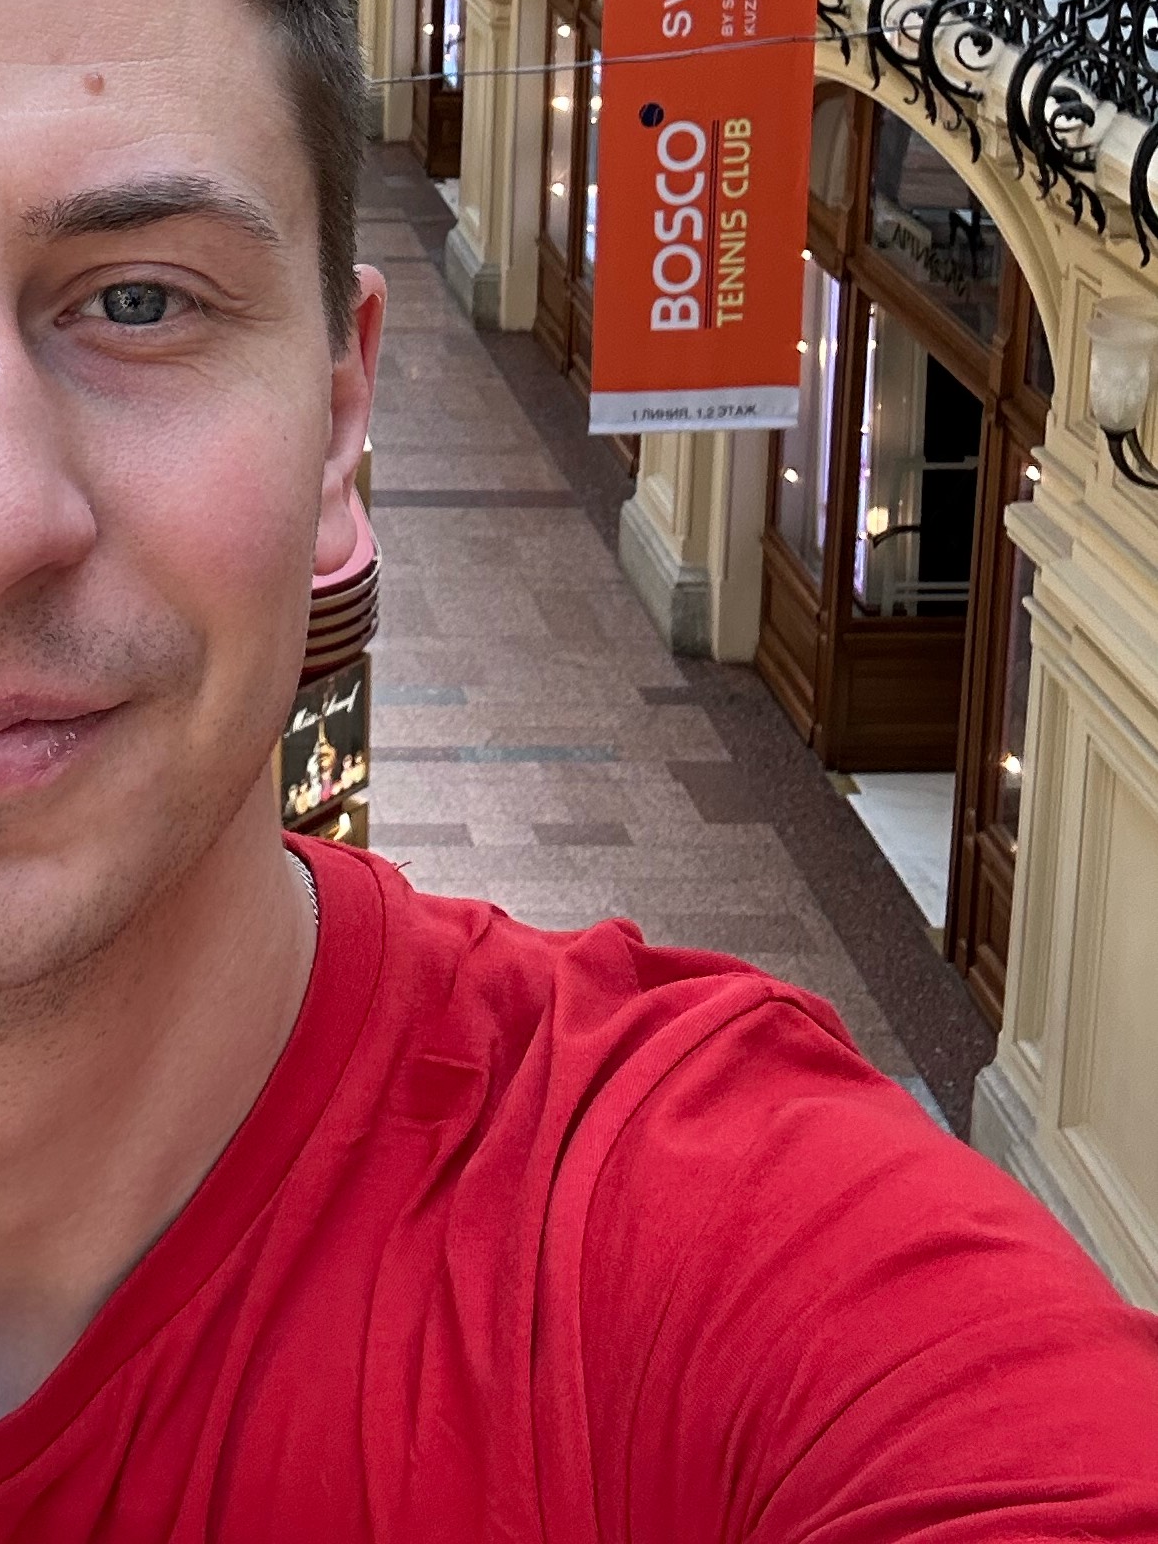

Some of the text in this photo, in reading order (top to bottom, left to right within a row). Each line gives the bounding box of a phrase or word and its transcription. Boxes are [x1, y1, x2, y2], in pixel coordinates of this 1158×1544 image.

[721, 13, 734, 37] BY
[650, 120, 707, 332] BOSCO
[716, 117, 752, 329] TENNIS CLUB
